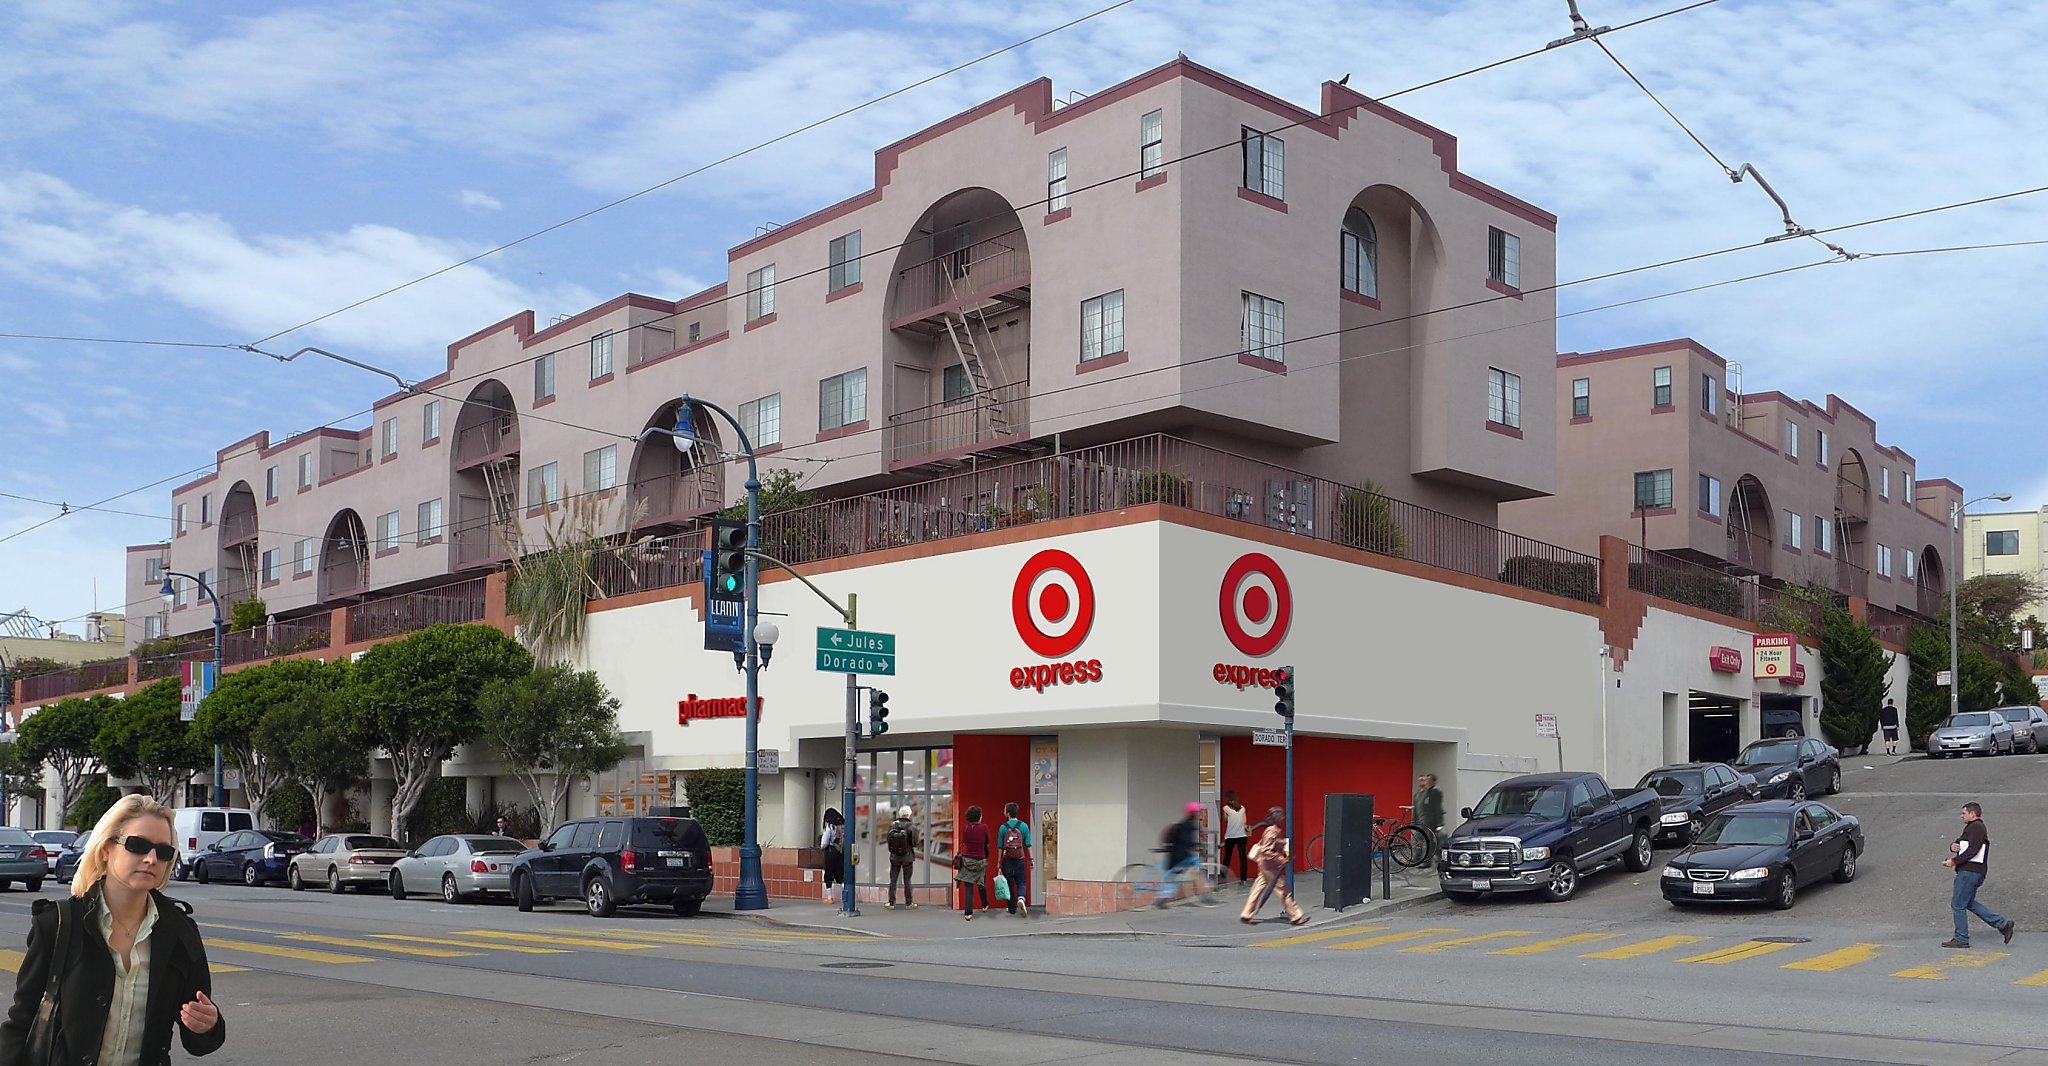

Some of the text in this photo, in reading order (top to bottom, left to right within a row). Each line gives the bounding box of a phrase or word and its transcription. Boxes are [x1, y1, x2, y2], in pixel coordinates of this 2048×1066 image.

[847, 634, 884, 650] Jules
[1756, 637, 1789, 646] PARKING
[823, 653, 873, 671] Dorado
[1721, 653, 1740, 669] Exit Only
[1009, 659, 1103, 694] express
[1213, 663, 1281, 691] expres
[1255, 733, 1275, 743] DORADO
